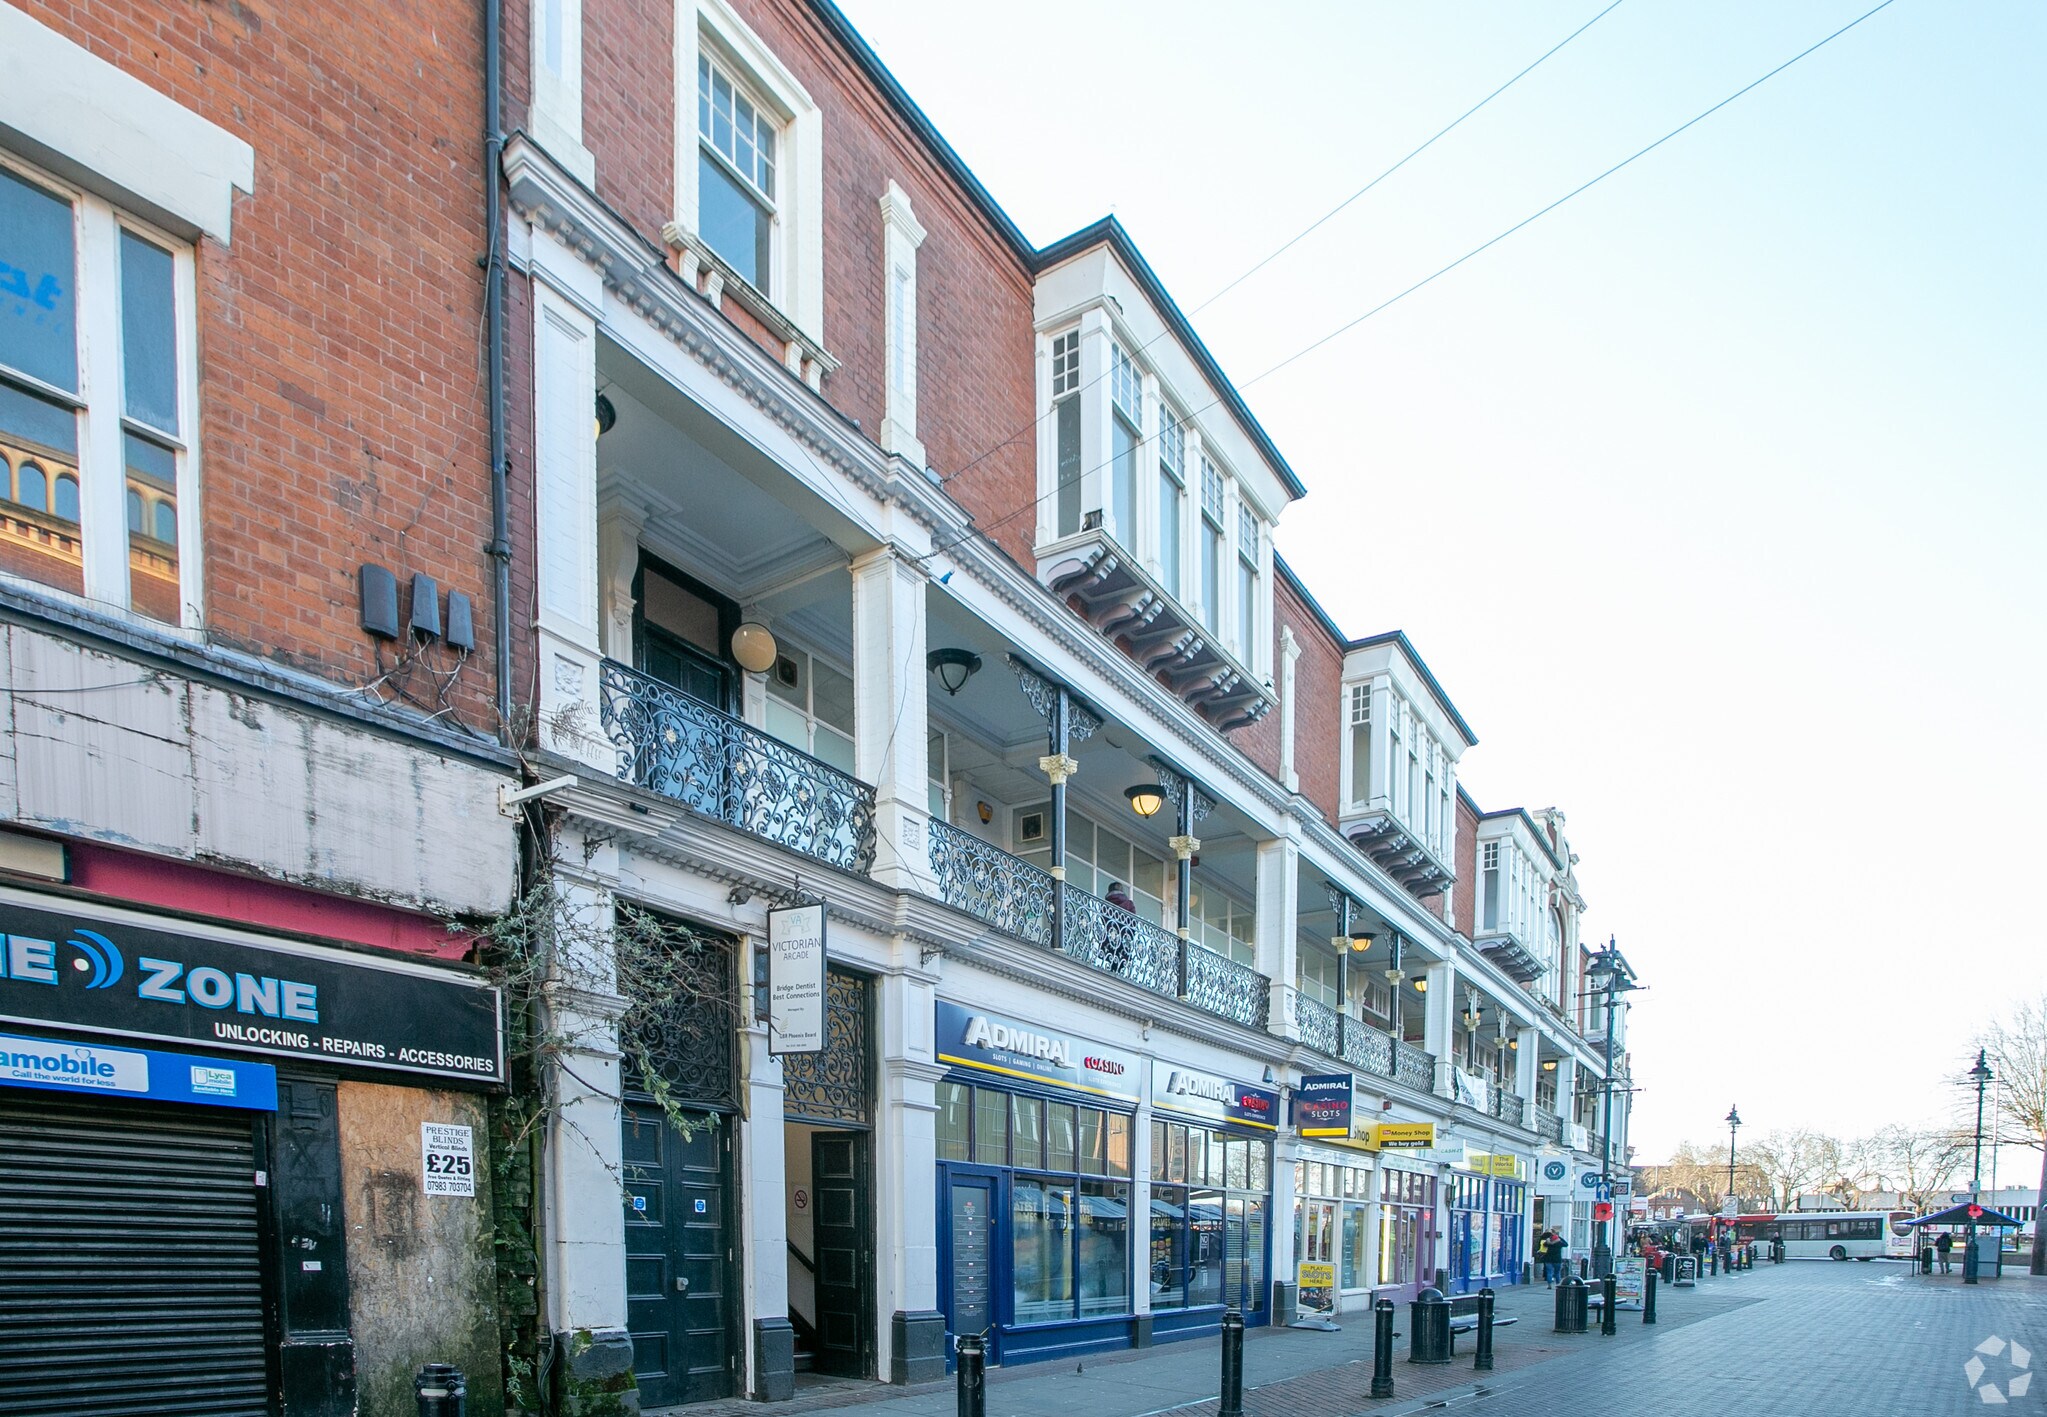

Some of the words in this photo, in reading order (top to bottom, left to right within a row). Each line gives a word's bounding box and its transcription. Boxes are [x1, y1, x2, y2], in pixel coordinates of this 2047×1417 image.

[772, 937, 821, 952] VICTORIAN
[783, 950, 809, 960] ARCADE
[138, 956, 319, 1024] ZONE
[795, 982, 816, 990] Dentist
[786, 991, 820, 1000] Connections
[214, 1022, 309, 1049] UNLOCKING
[322, 1037, 386, 1059] REPAIRS
[398, 1048, 494, 1072] ACCESSORIES
[965, 1016, 1077, 1068] ADMIRAL
[992, 1053, 1008, 1063] SLOTS
[1013, 1058, 1031, 1069] GAMING
[1036, 1062, 1053, 1073] ONLINE
[1084, 1057, 1125, 1076] CASINO
[12, 1069, 32, 1079] Call
[34, 1070, 51, 1081] the
[52, 1073, 80, 1084] world
[81, 1076, 97, 1085] for
[97, 1078, 116, 1087] less
[208, 1070, 232, 1080] Lyca
[1168, 1071, 1240, 1107] ADMIRAL
[1304, 1081, 1349, 1091] ADMIRAL
[1242, 1095, 1270, 1112] CASINO
[1303, 1101, 1348, 1111] CASINO
[426, 1126, 470, 1138] PRESTIGE
[433, 1135, 464, 1145] BLINDS
[1399, 1140, 1409, 1148] buy
[1410, 1140, 1424, 1148] gold
[427, 1153, 471, 1175] £25
[427, 1180, 447, 1191] 07983
[448, 1181, 472, 1193] 703704
[1152, 1218, 1171, 1228] GAMES
[1302, 1270, 1331, 1280] SLOTS
